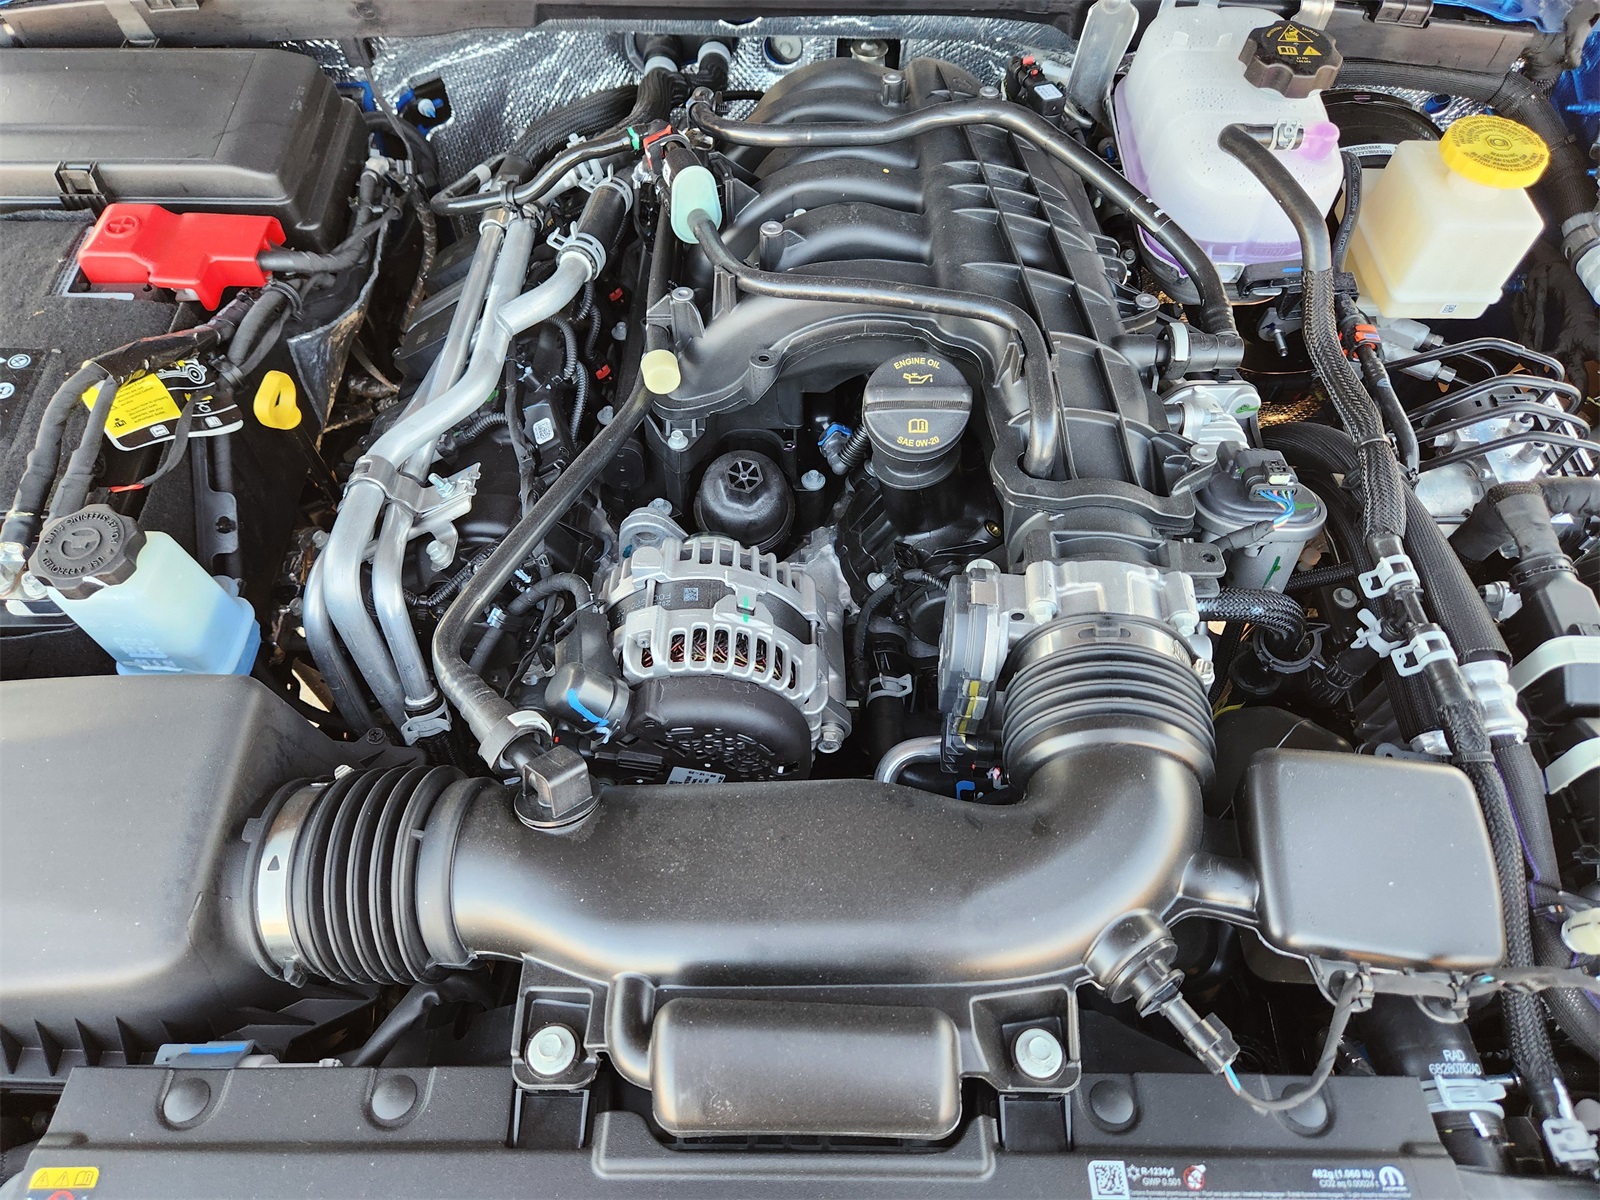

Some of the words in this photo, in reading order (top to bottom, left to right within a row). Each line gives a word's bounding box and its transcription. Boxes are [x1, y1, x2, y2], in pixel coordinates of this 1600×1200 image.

[1344, 214, 1355, 231] BRAKE
[893, 357, 926, 370] ENGINE
[927, 359, 941, 370] OIL
[897, 436, 914, 447] SAE
[915, 436, 940, 447] 0W-20
[43, 523, 65, 545] FLUID
[105, 517, 119, 545] POWER
[41, 556, 85, 575] APPROVED
[86, 554, 105, 569] USE
[1443, 1049, 1466, 1062] RAD
[1361, 1168, 1376, 1180] lb)
[1142, 1177, 1161, 1187] GWP
[1319, 1179, 1336, 1188] CO2
